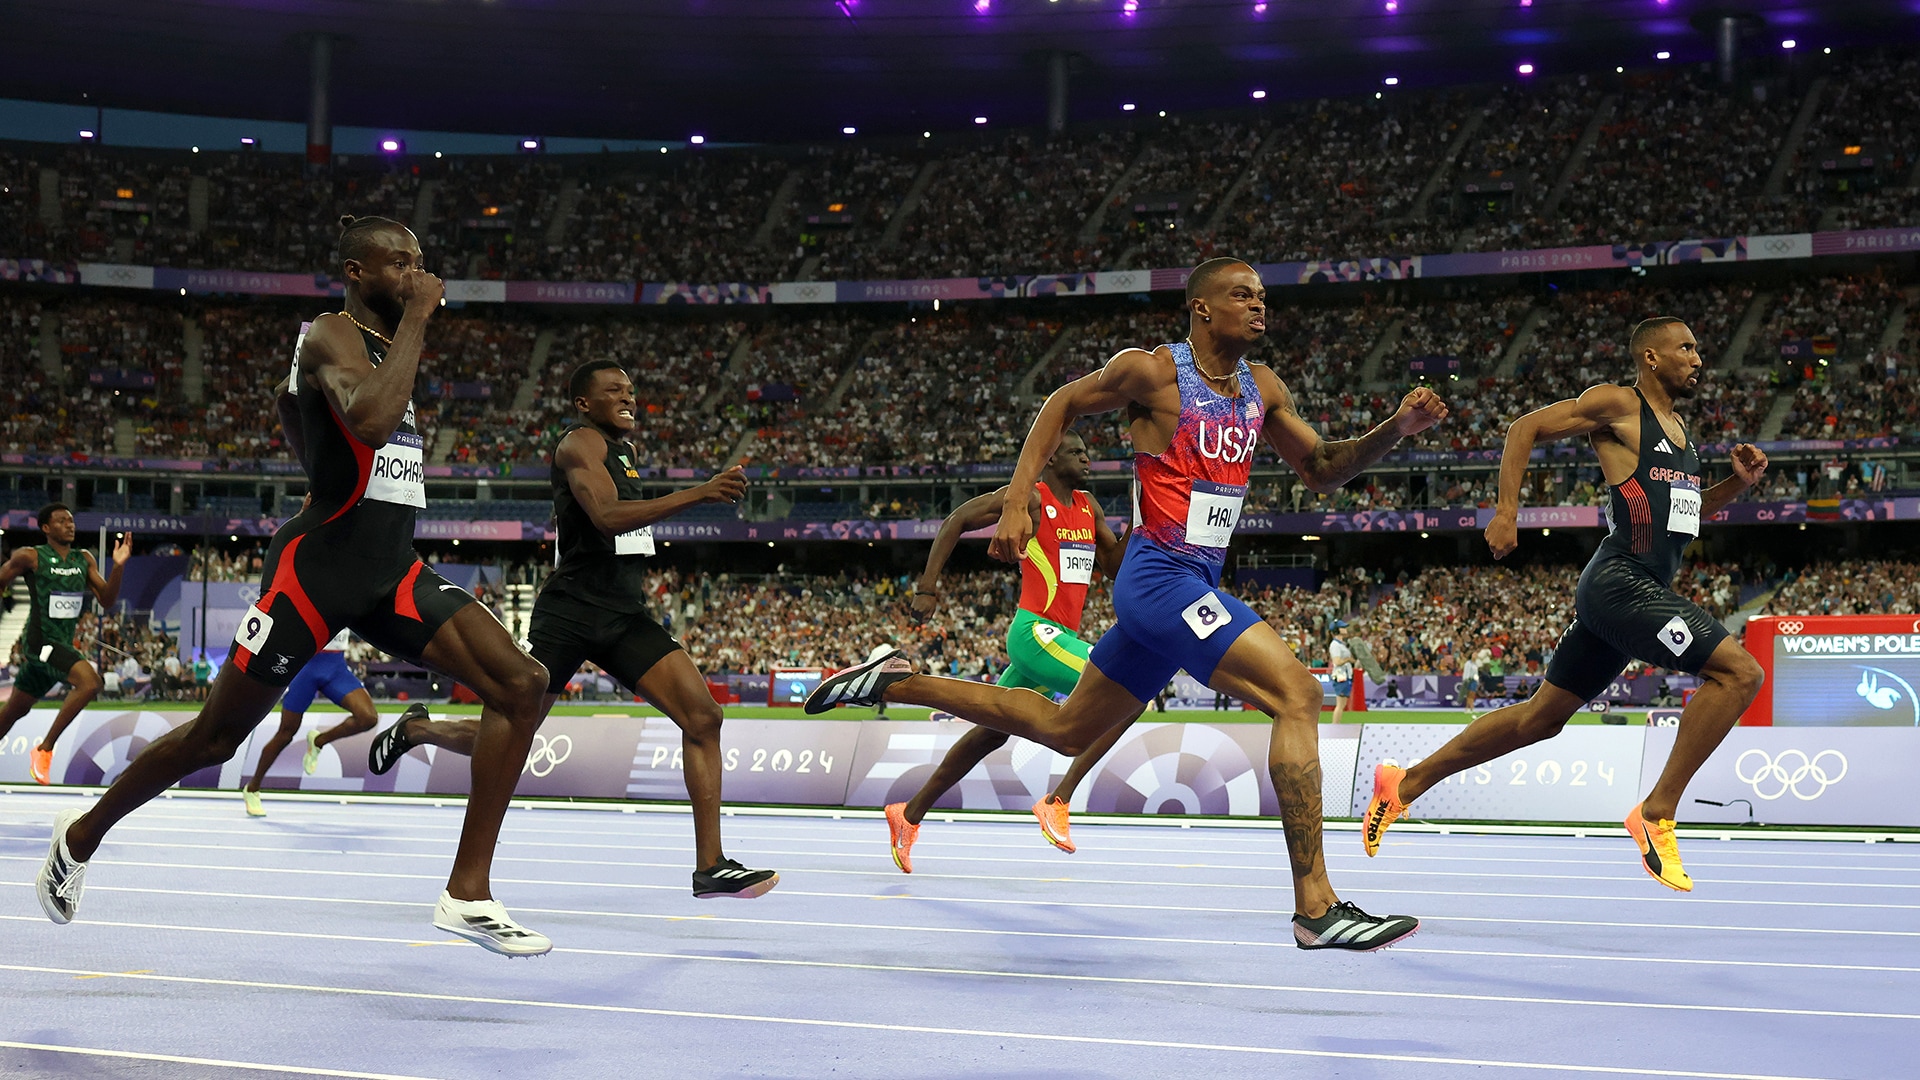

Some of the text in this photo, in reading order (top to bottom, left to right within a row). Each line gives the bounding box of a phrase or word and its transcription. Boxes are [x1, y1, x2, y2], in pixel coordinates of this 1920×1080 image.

[1846, 235, 1894, 248] PARIS
[1502, 253, 1592, 268] PARIS 2024
[537, 287, 625, 299] PARIS 2024
[866, 284, 950, 297] PARIS 2024
[1200, 420, 1257, 463] USA
[1649, 466, 1685, 484] GREAT
[104, 517, 187, 530] PARIS 2024
[1240, 518, 1272, 529] 2024
[1426, 517, 1439, 527] H1
[1541, 512, 1577, 522] 2024
[421, 523, 460, 534] PARIS
[688, 525, 721, 536] 2024
[1056, 527, 1093, 541] GRENADA
[1066, 556, 1092, 571] JAMES
[1197, 605, 1217, 626] 8
[247, 617, 261, 641] 9
[1670, 629, 1685, 645] 6
[1783, 635, 1920, 653] WOMEN'S POLE
[750, 748, 834, 773] 2024
[1509, 759, 1615, 786] 2024
[1368, 799, 1390, 842] NITRO
